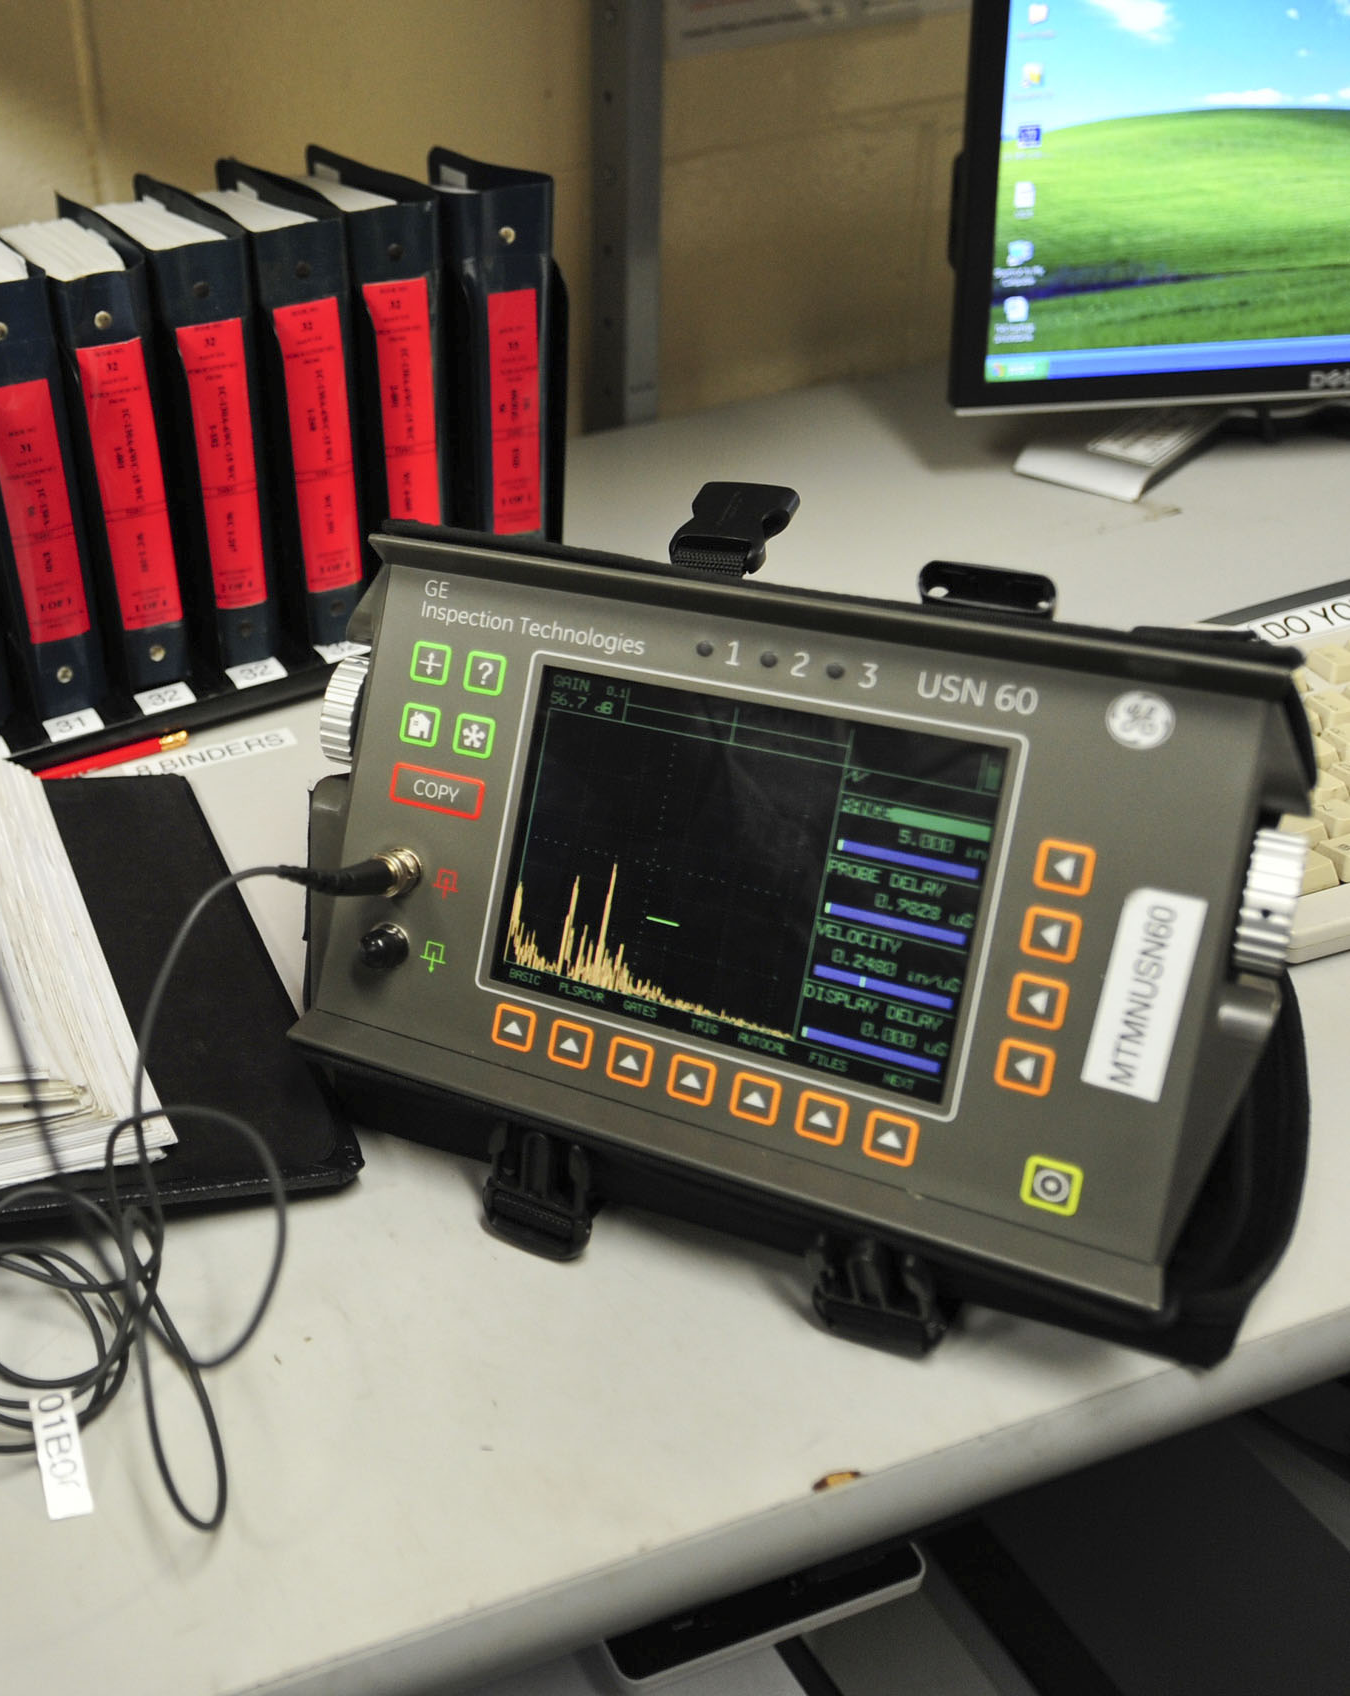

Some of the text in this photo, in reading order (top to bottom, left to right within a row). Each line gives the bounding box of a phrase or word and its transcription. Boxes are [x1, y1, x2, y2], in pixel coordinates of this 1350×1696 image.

[424, 580, 450, 599] GE
[421, 601, 646, 655] Inspection Technologies
[1261, 602, 1350, 639] DO YO
[725, 641, 740, 666] 1
[790, 652, 810, 677] 2
[239, 664, 270, 682] 32
[553, 674, 591, 692] GAIN
[858, 663, 879, 689] 3
[148, 689, 178, 706] 32
[917, 671, 1039, 715] USN 60
[56, 717, 87, 733] 31
[159, 732, 286, 773] BINDERS
[413, 779, 460, 803] COPY
[826, 859, 947, 897] PROBE DELAY
[815, 920, 903, 954] VELOCITY
[509, 968, 542, 986] BASIC
[803, 983, 944, 1031] DISPLAY DELAY
[1107, 904, 1178, 1087] MTMNUSN60
[623, 1000, 658, 1019] GATES
[691, 1018, 720, 1036] TRIG
[809, 1052, 849, 1073] FILES
